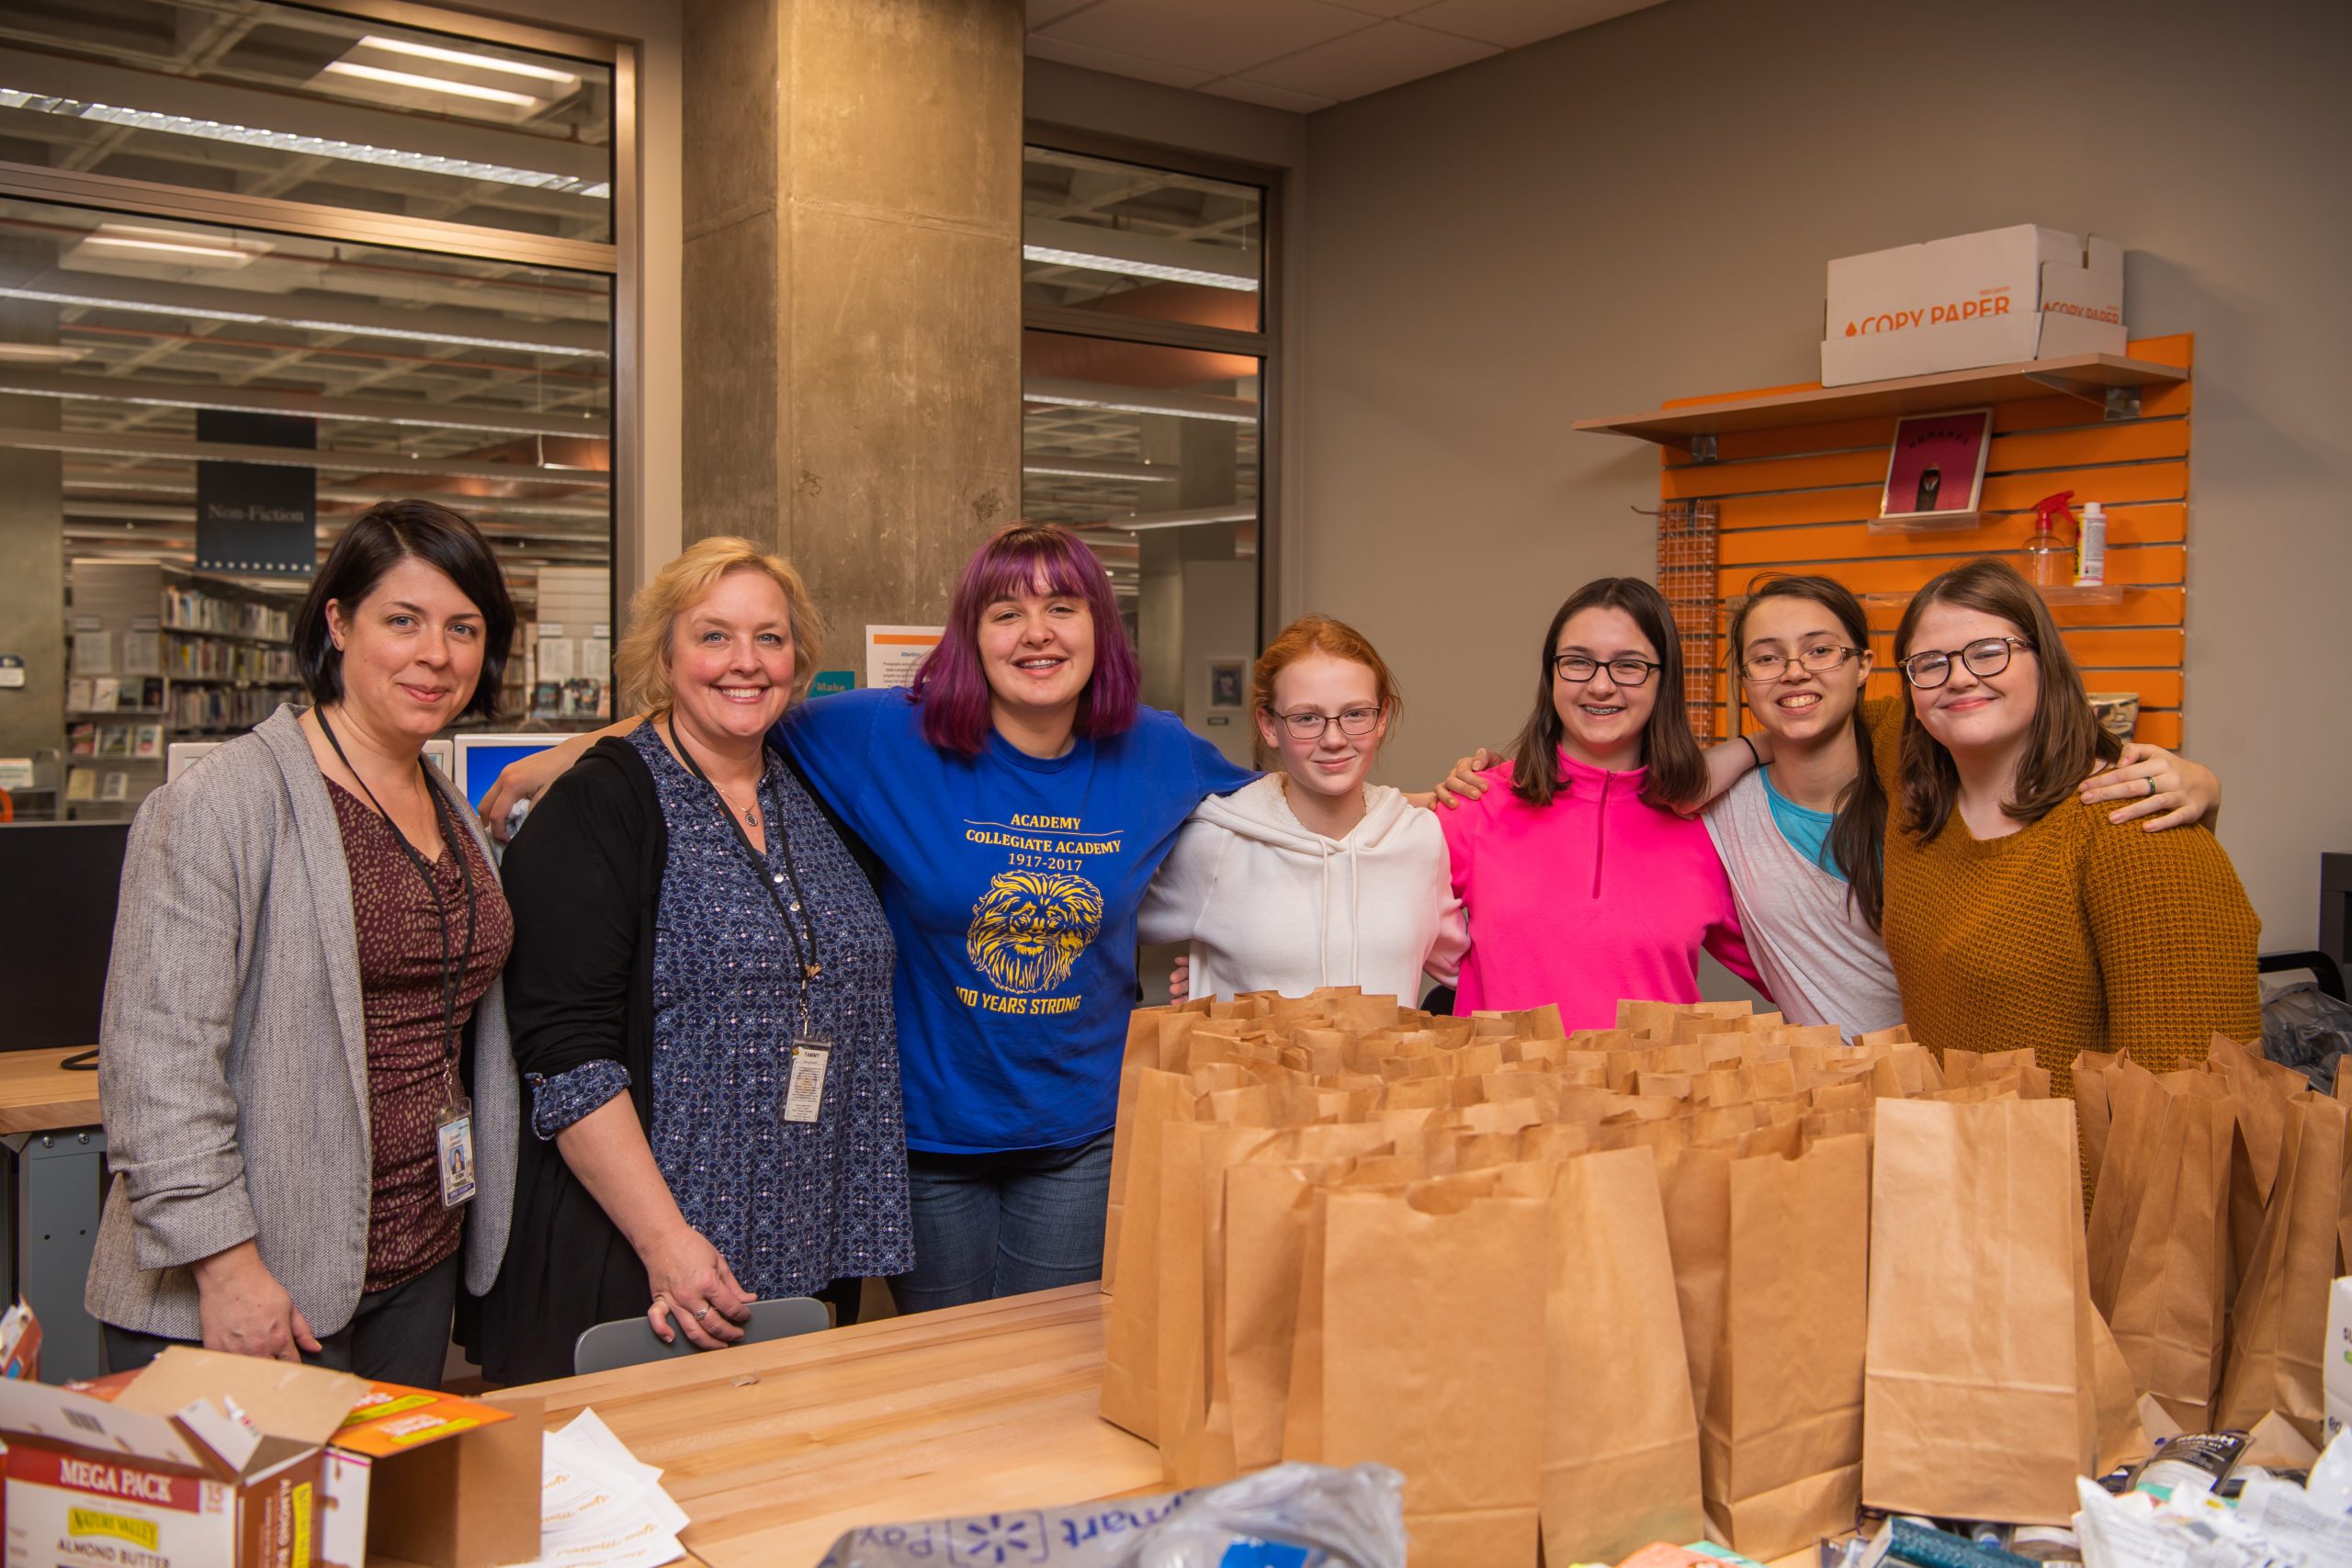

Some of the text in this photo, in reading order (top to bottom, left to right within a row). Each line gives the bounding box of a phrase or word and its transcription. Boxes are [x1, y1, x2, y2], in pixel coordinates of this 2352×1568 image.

[1930, 295, 2010, 325] PAPER
[208, 503, 305, 523] Non-Fiction
[1011, 814, 1081, 829] ACADEMY
[966, 829, 1121, 855] COLLEGIATE ACADEMY
[1008, 852, 1082, 872] 1917-2017
[982, 993, 1026, 1015] YEARS
[1030, 995, 1081, 1015] STRONG
[60, 1458, 173, 1503] MEGA PACK
[57, 1537, 171, 1568] ALMOND BUTTER
